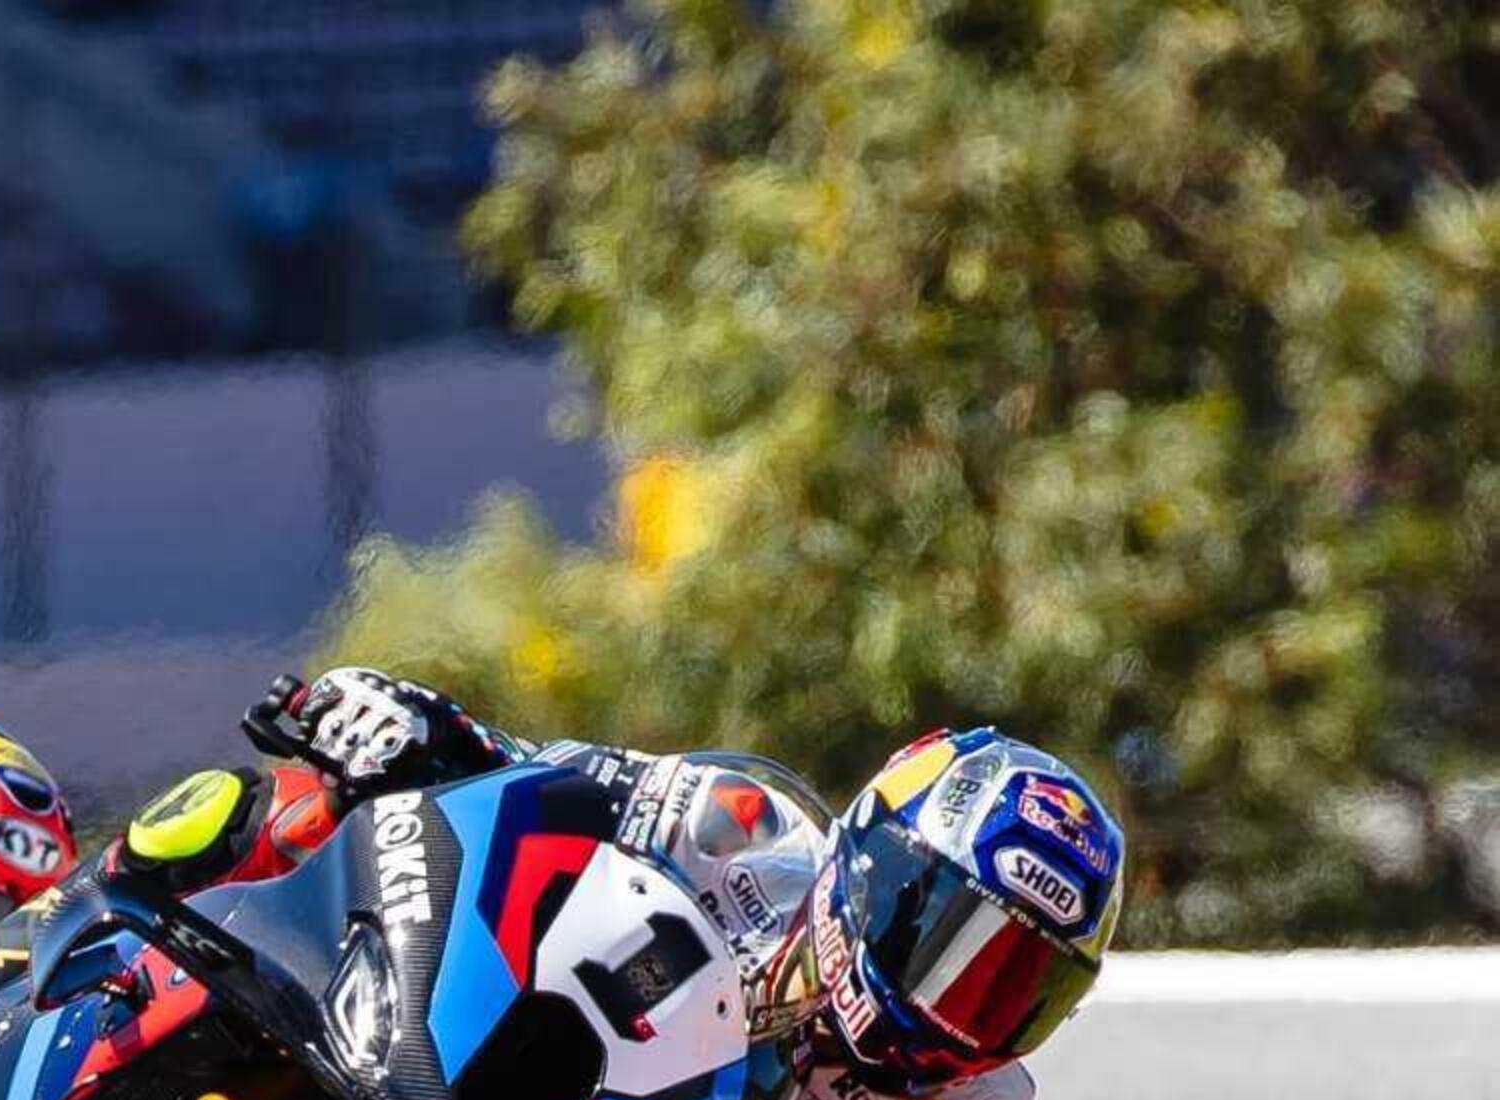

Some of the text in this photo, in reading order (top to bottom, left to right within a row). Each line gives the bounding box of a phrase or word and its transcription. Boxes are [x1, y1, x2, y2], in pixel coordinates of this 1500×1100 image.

[728, 873, 779, 934] SHOEI
[1009, 855, 1078, 915] SHOEI
[571, 911, 715, 1042] 1
